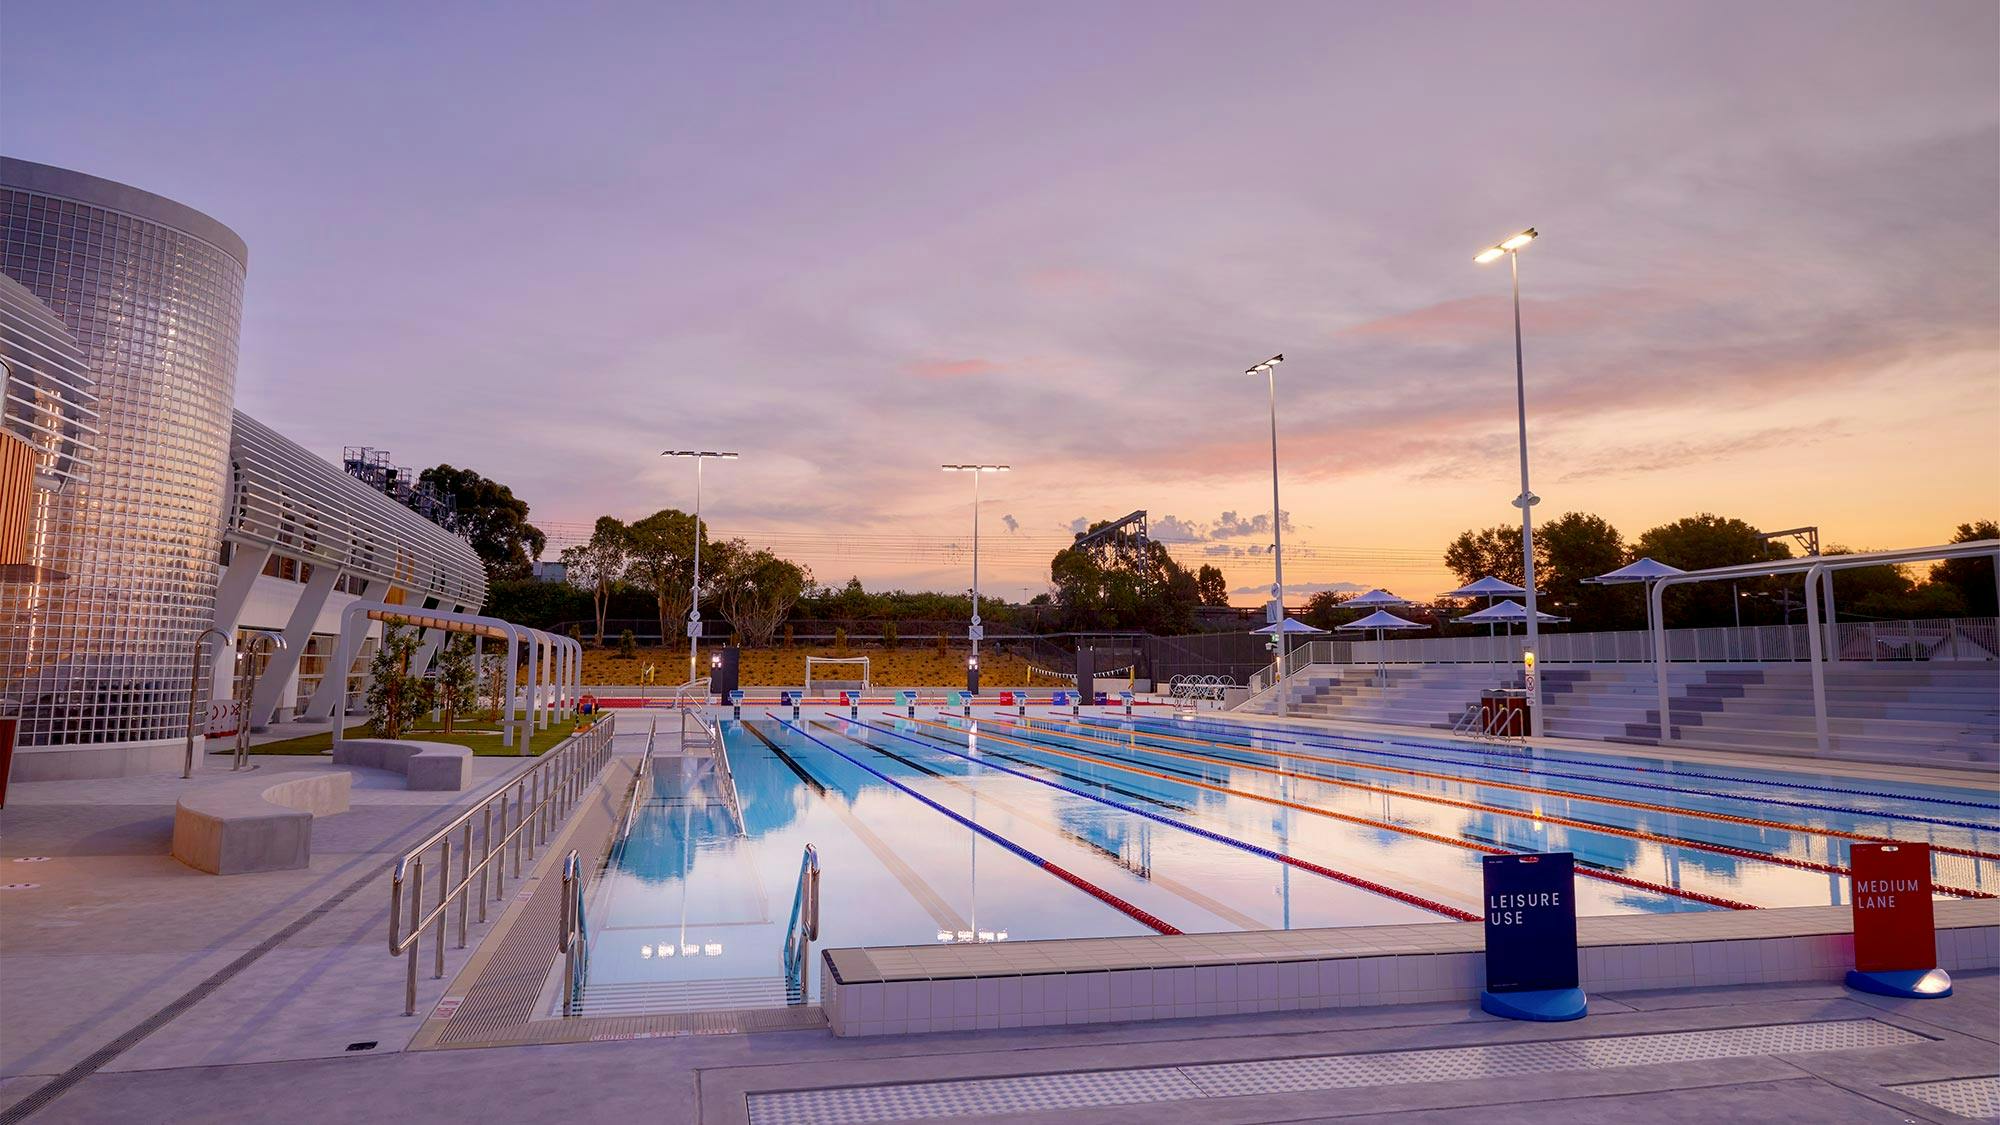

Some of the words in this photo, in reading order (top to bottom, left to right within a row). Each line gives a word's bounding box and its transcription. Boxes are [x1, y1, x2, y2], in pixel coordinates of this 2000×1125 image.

[1857, 880, 1919, 893] MEDIUM
[1491, 892, 1560, 909] LEISURE
[1858, 895, 1896, 909] LANE
[1491, 911, 1523, 926] USE
